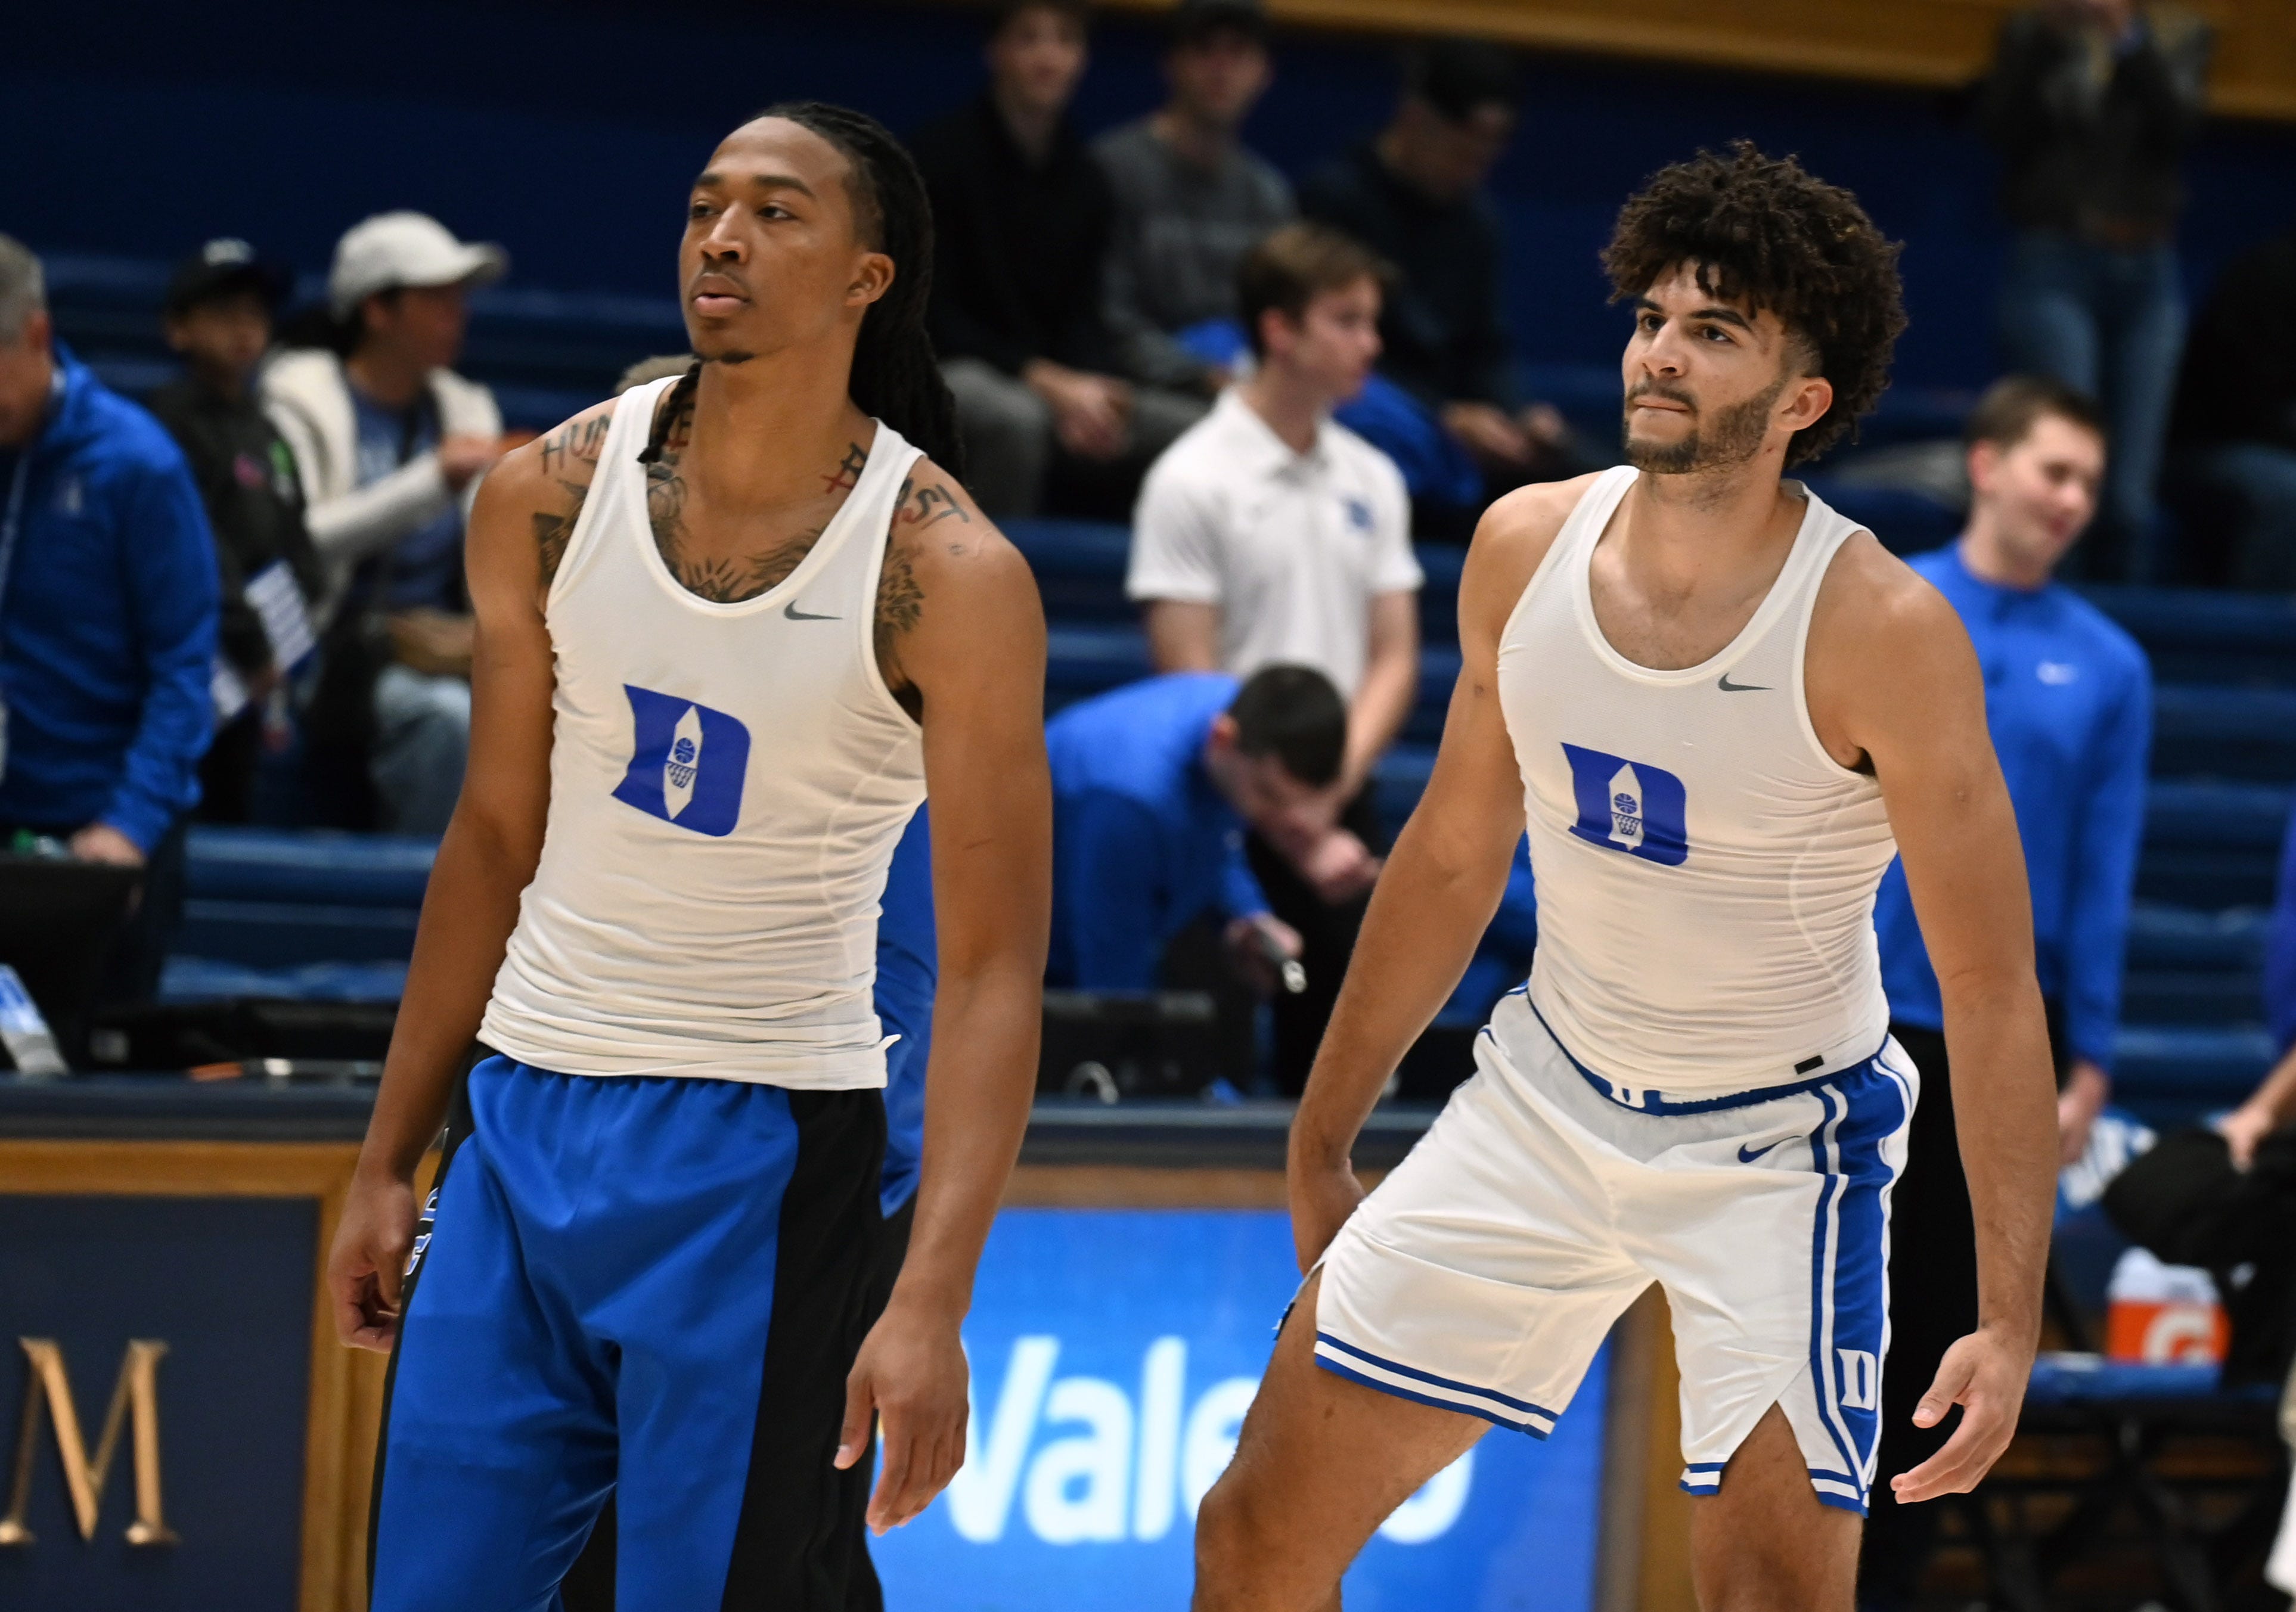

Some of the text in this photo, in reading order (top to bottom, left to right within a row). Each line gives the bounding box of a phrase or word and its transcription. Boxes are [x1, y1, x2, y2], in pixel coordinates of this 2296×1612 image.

[610, 684, 751, 837] D
[1560, 741, 1689, 866] D
[0, 1337, 179, 1545] M
[944, 1334, 1475, 1545] Vale
[1836, 1347, 1876, 1411] D
